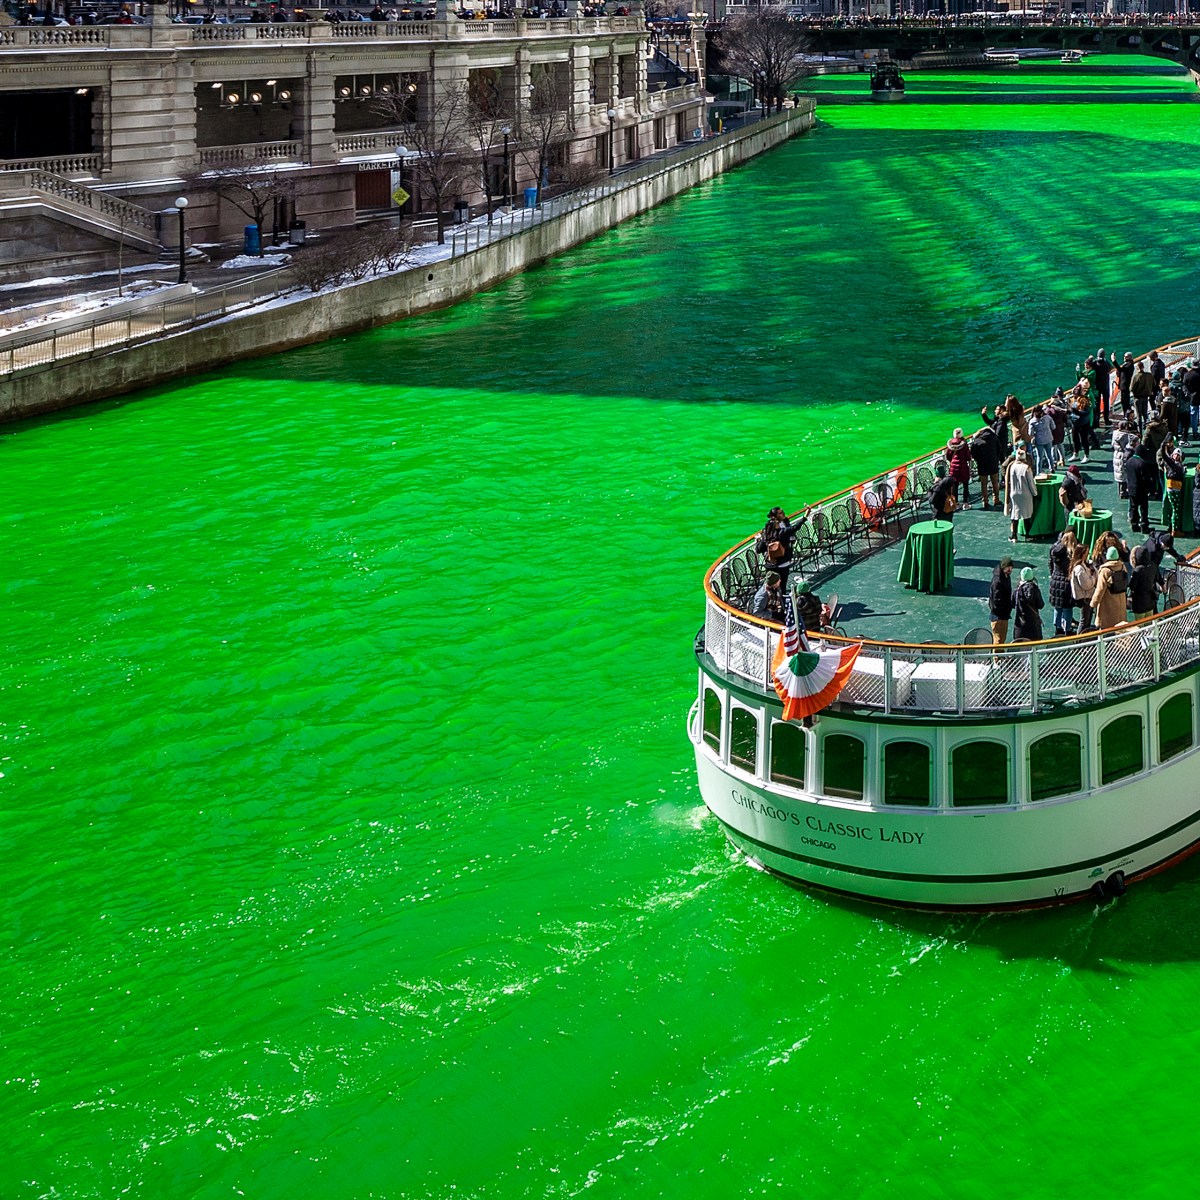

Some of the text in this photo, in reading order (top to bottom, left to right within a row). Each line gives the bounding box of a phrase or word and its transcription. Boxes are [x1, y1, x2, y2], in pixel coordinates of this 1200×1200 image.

[731, 789, 925, 845] CHICAGO'S CLASSIC LADY
[801, 836, 837, 851] CHICAGO
